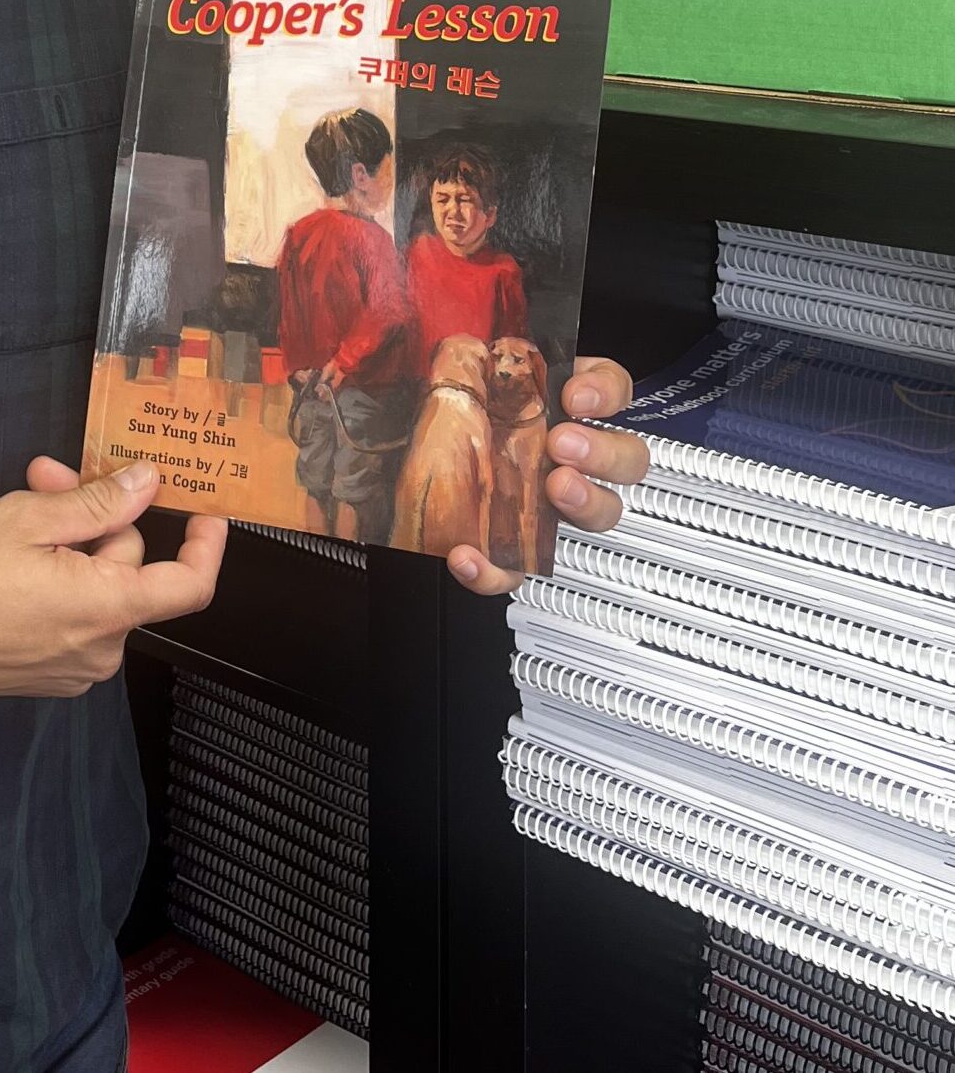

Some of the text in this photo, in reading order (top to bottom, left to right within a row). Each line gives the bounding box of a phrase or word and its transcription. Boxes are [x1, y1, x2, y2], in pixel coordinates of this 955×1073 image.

[357, 56, 501, 99] 쿠퍼의 레슨
[690, 331, 762, 379] matters
[726, 339, 793, 387] curriculum
[144, 401, 179, 420] Story
[183, 407, 199, 423] by
[128, 418, 236, 447] Sun Yung Shin
[109, 444, 191, 468] Illustrations
[196, 457, 212, 474] by
[172, 474, 216, 493] Cogan
